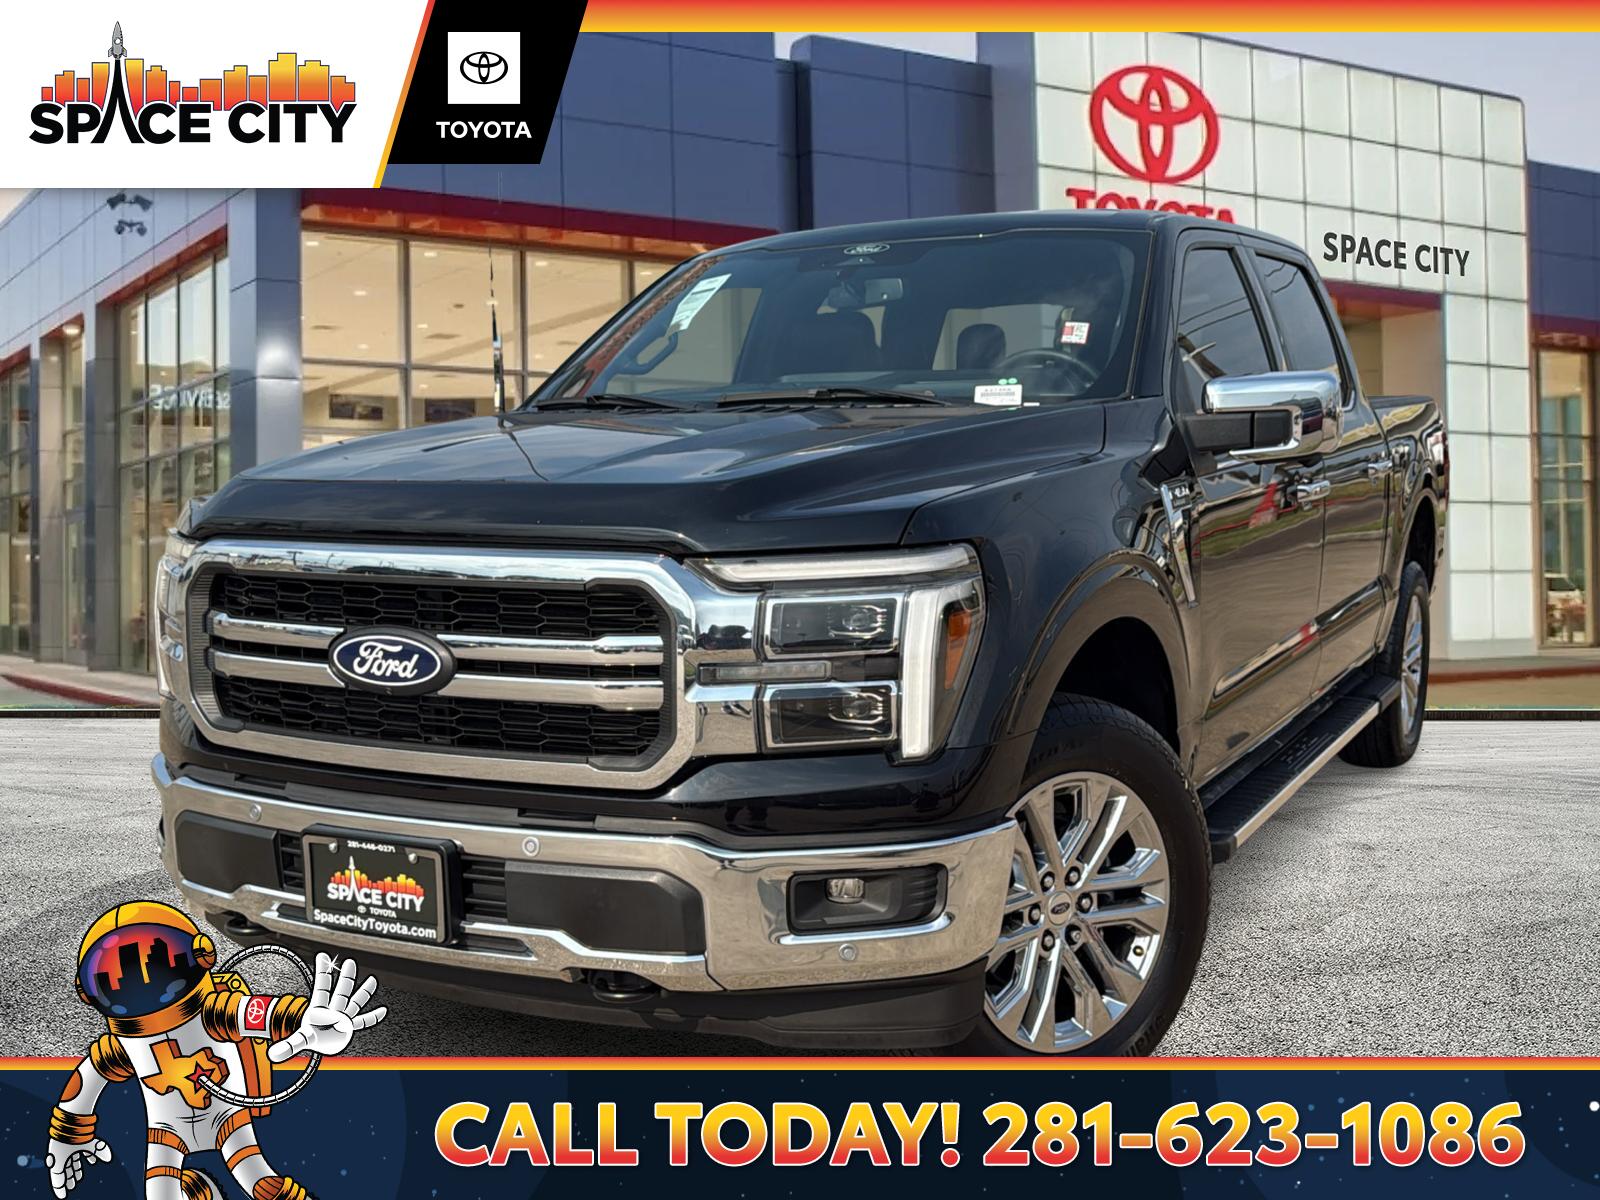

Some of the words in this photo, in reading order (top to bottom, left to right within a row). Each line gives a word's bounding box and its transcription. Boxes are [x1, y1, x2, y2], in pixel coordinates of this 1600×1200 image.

[1322, 231, 1407, 270] SPACE
[1414, 244, 1471, 277] CITY
[353, 641, 419, 679] Ford
[327, 869, 383, 905] SPACE
[385, 890, 425, 913] CITY
[313, 908, 437, 940] SpaceCityToyota.com
[369, 906, 397, 919] TOYOTA
